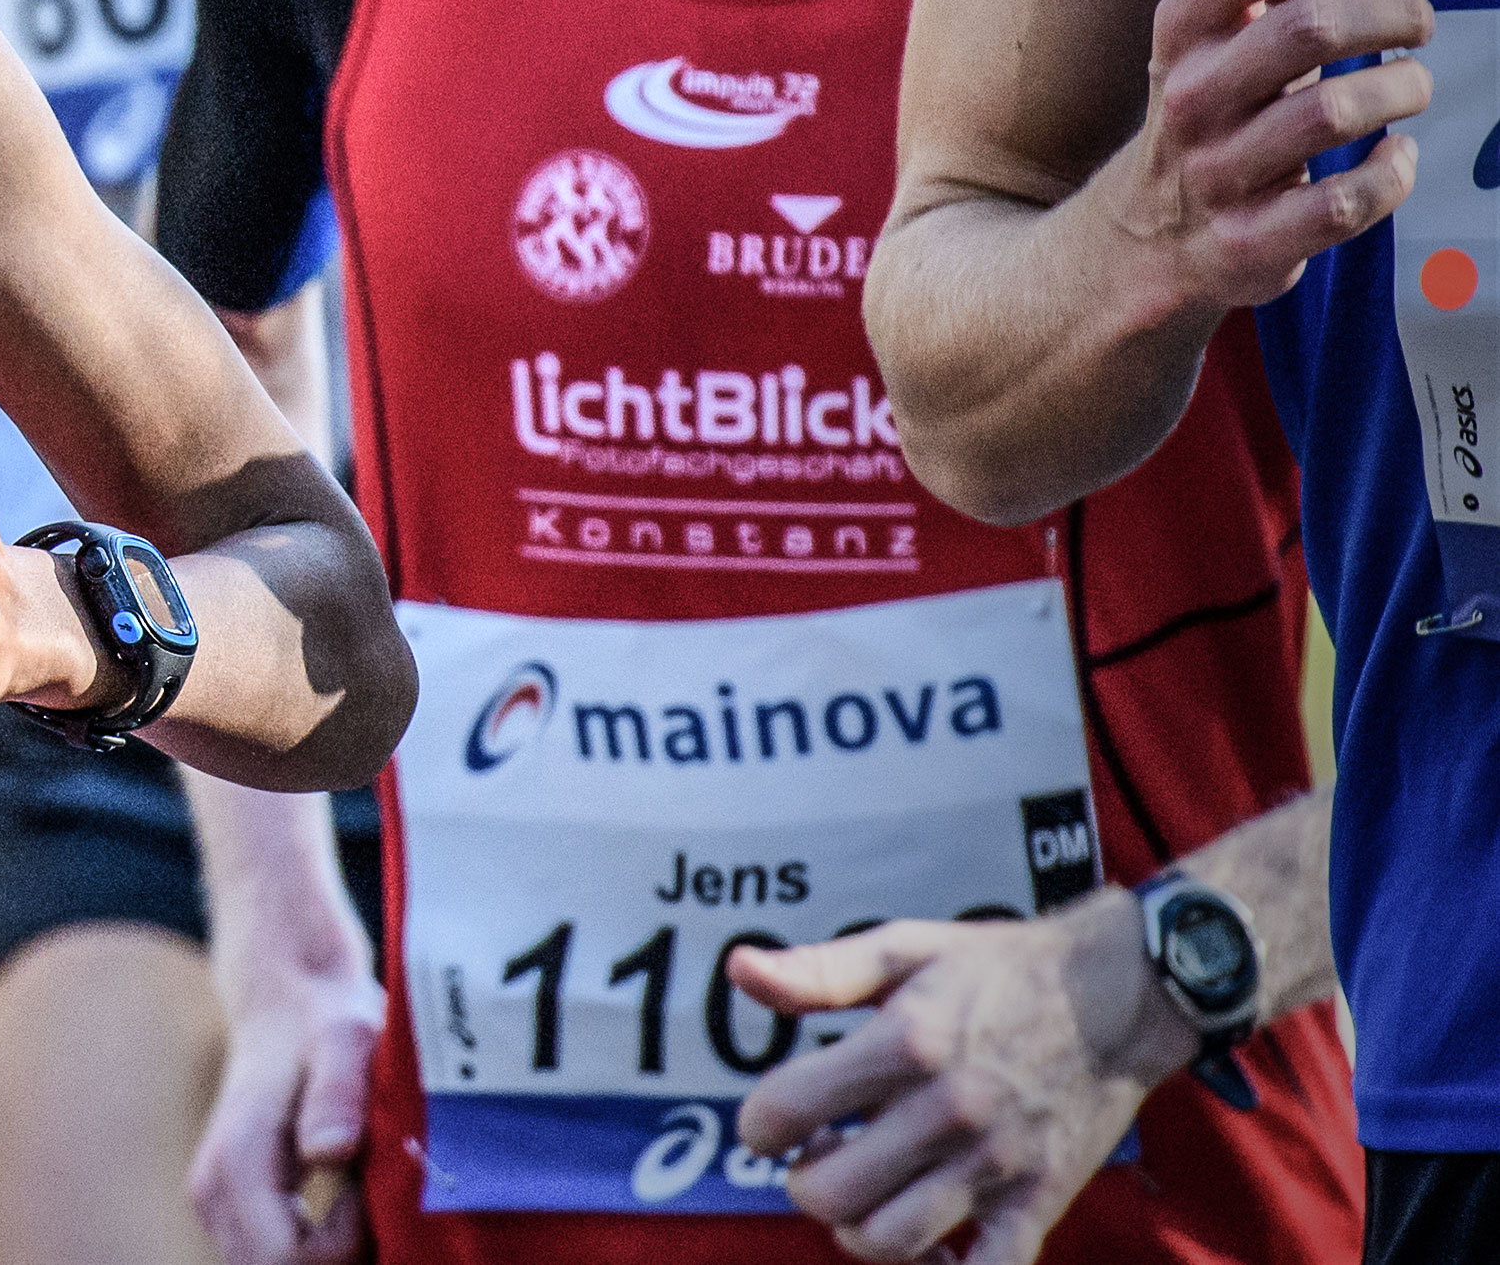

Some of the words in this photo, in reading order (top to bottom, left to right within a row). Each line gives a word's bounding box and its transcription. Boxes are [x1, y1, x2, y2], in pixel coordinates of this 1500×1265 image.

[529, 504, 917, 557] Konstanz
[571, 672, 1004, 767] mainova
[1033, 821, 1090, 870] DM
[654, 849, 813, 906] Jens
